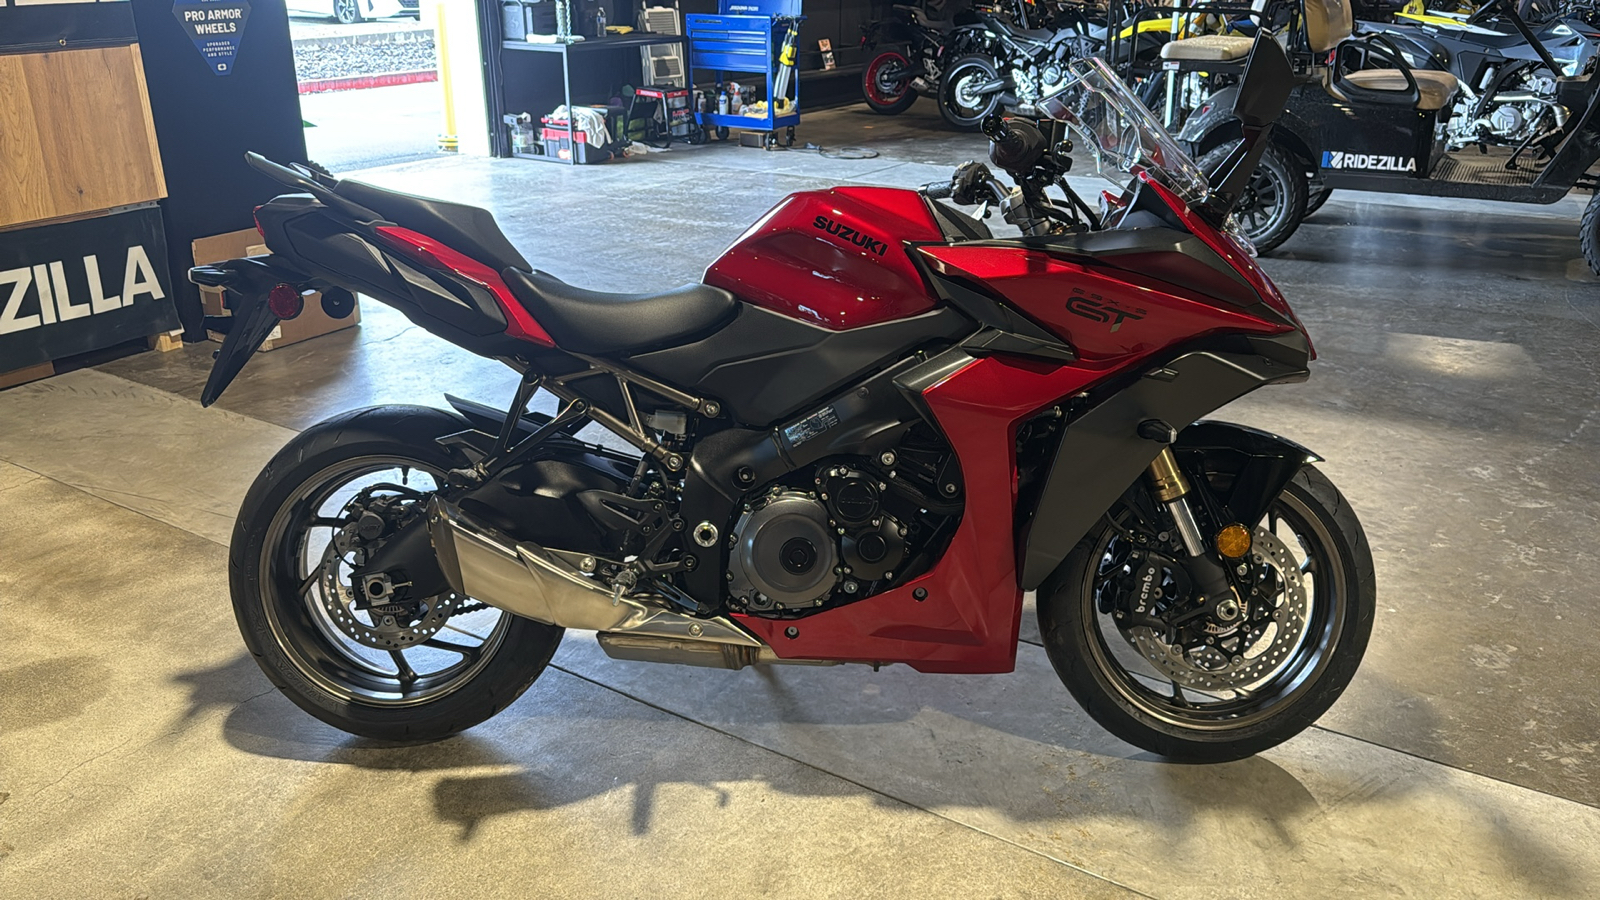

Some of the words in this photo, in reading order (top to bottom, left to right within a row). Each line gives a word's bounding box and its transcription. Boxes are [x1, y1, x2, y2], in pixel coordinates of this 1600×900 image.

[184, 10, 206, 22] PRO
[207, 8, 242, 21] ARMOR
[194, 22, 237, 35] WHEELS
[1343, 153, 1417, 172] RIDEZILLA
[812, 215, 889, 257] SUZUKI
[0, 244, 166, 336] ZILLA
[1135, 567, 1156, 613] brembo
